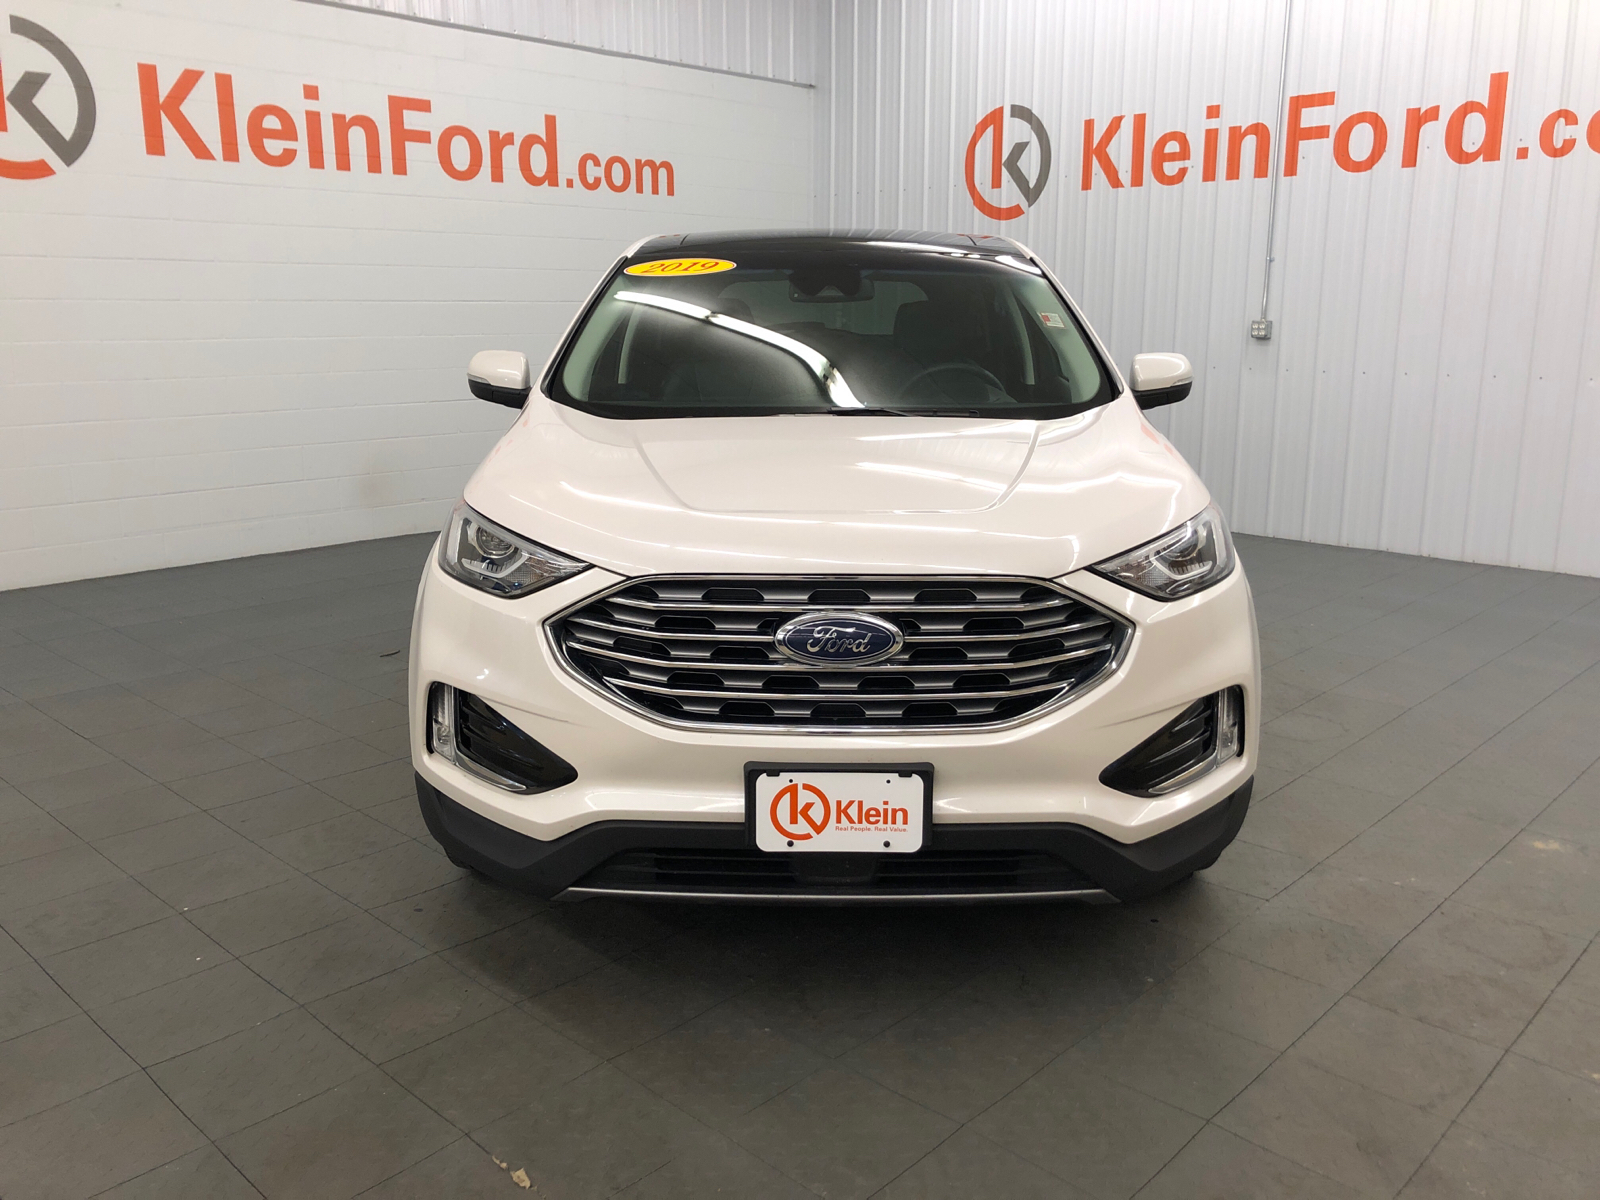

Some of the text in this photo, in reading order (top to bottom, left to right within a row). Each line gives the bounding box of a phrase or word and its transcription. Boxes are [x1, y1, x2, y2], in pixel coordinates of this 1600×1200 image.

[137, 62, 675, 197] KleinFord.com
[640, 261, 720, 274] 2019
[806, 625, 873, 653] Ford
[835, 799, 909, 825] Klein
[850, 825, 873, 833] People.
[889, 825, 909, 833] Value.
